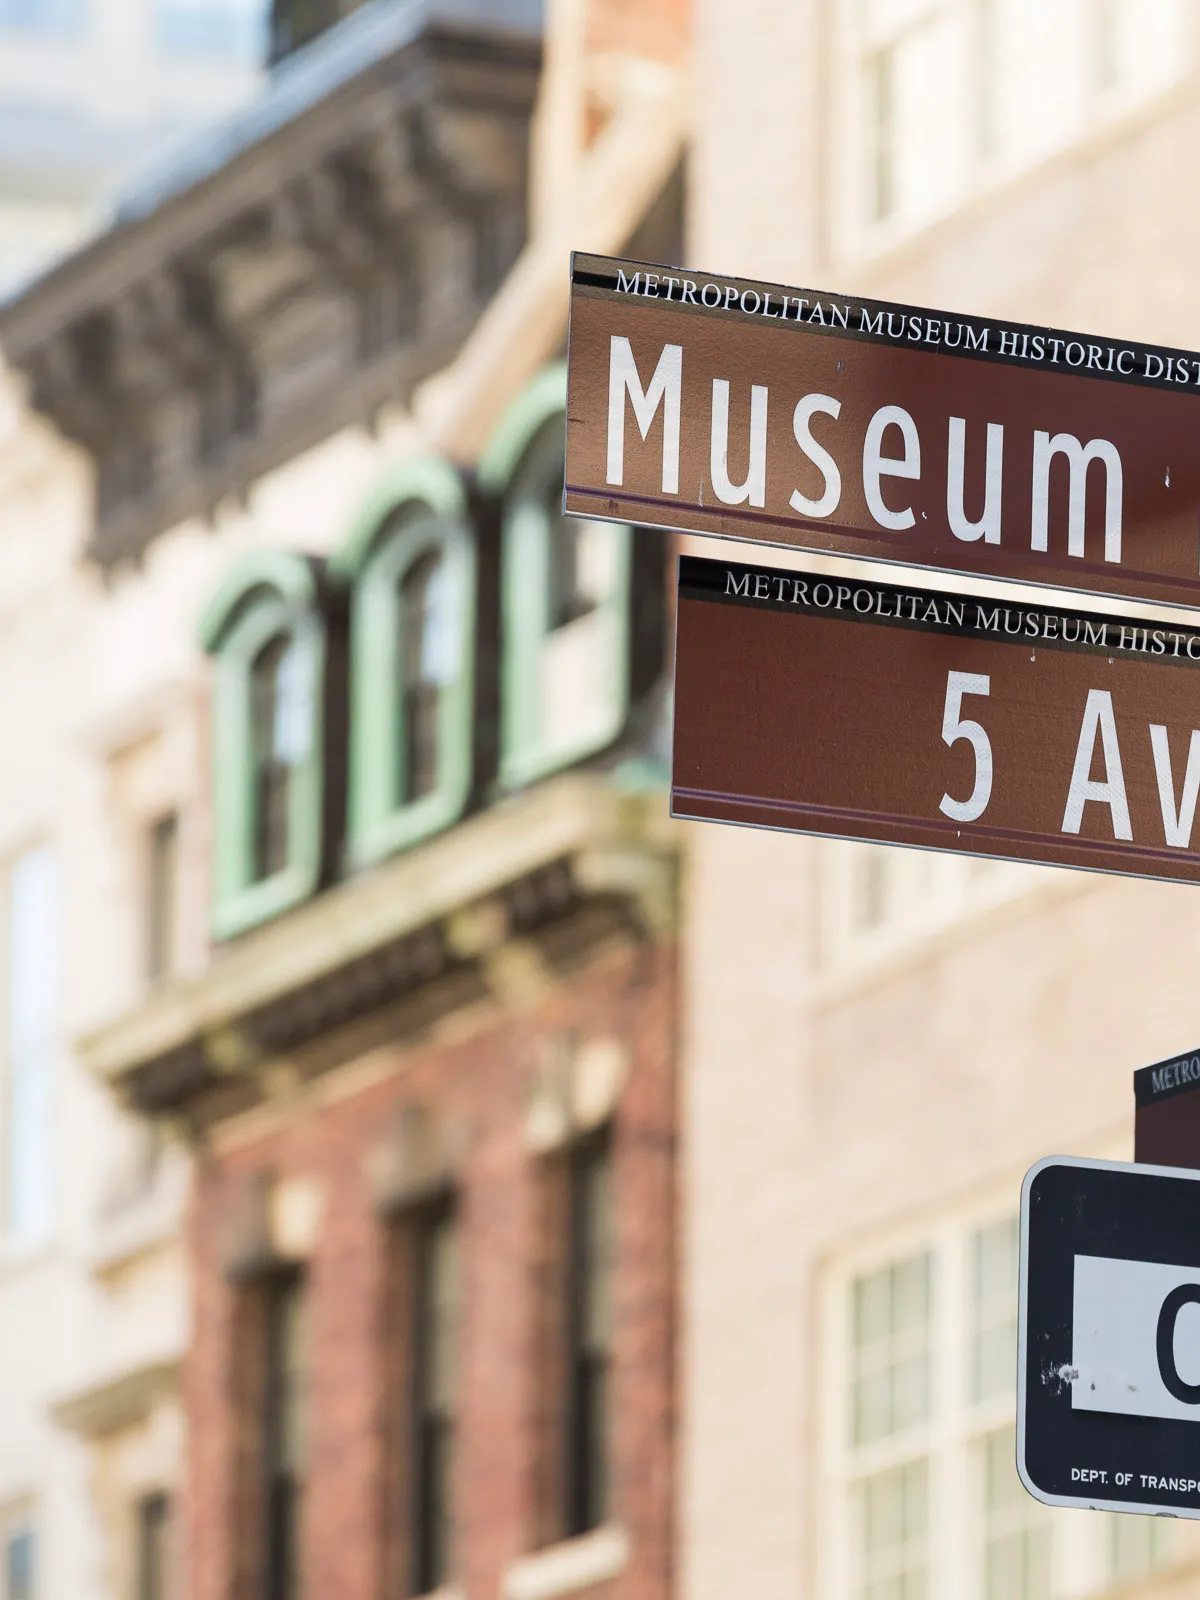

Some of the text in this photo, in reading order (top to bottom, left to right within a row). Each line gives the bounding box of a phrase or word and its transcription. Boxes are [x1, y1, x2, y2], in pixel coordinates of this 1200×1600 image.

[613, 269, 852, 328] METROPOLITAN
[858, 307, 991, 351] MUSEUM
[997, 330, 1136, 375] HISTORIC
[606, 335, 1123, 564] Museum
[723, 570, 966, 626] METROPOLITAN
[974, 605, 1109, 646] MUSEUM
[938, 669, 993, 822] 5
[1070, 1468, 1109, 1485] DEPT.
[1114, 1473, 1134, 1487] OF
